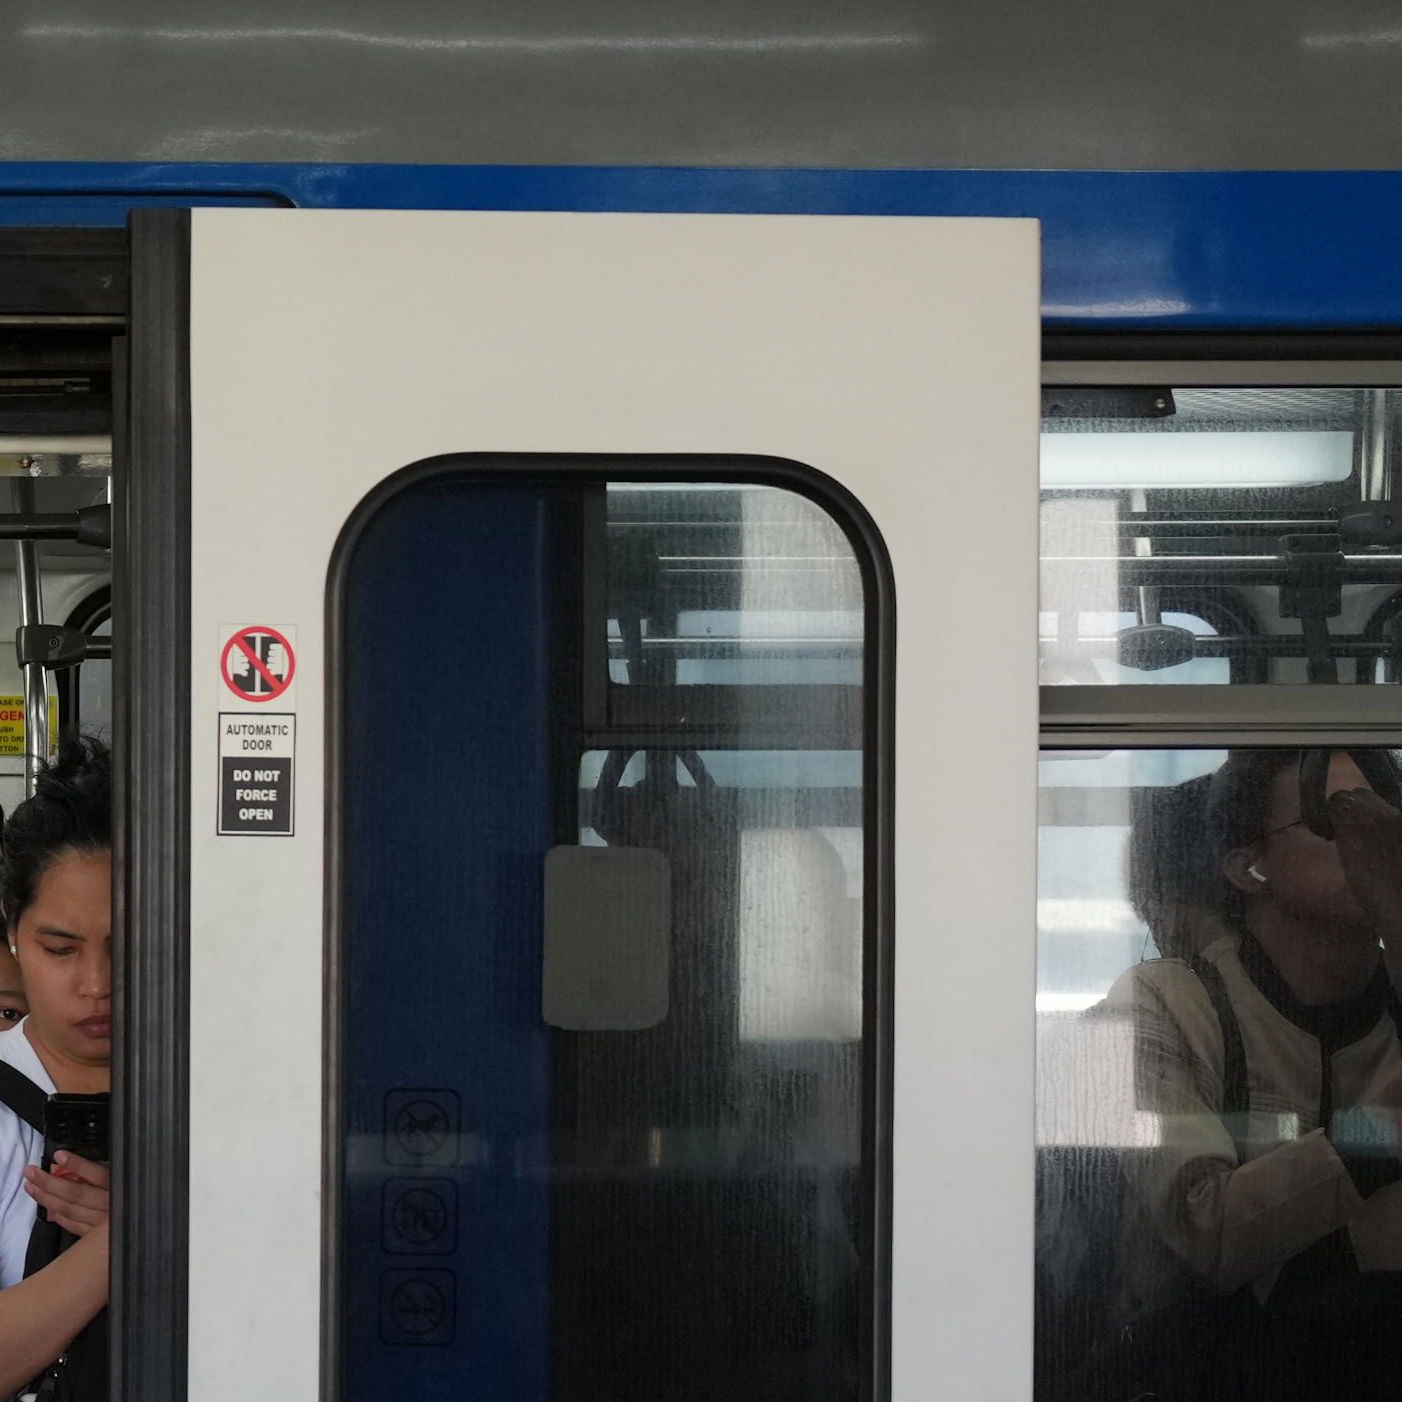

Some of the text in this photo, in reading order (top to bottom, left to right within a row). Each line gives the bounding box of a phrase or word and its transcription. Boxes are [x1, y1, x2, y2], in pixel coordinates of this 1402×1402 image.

[226, 725, 289, 736] AUTOMATIC
[242, 740, 272, 751] DOOR
[233, 770, 281, 782] DO NOT
[235, 789, 277, 801] FORCE
[238, 809, 273, 820] OPEN
